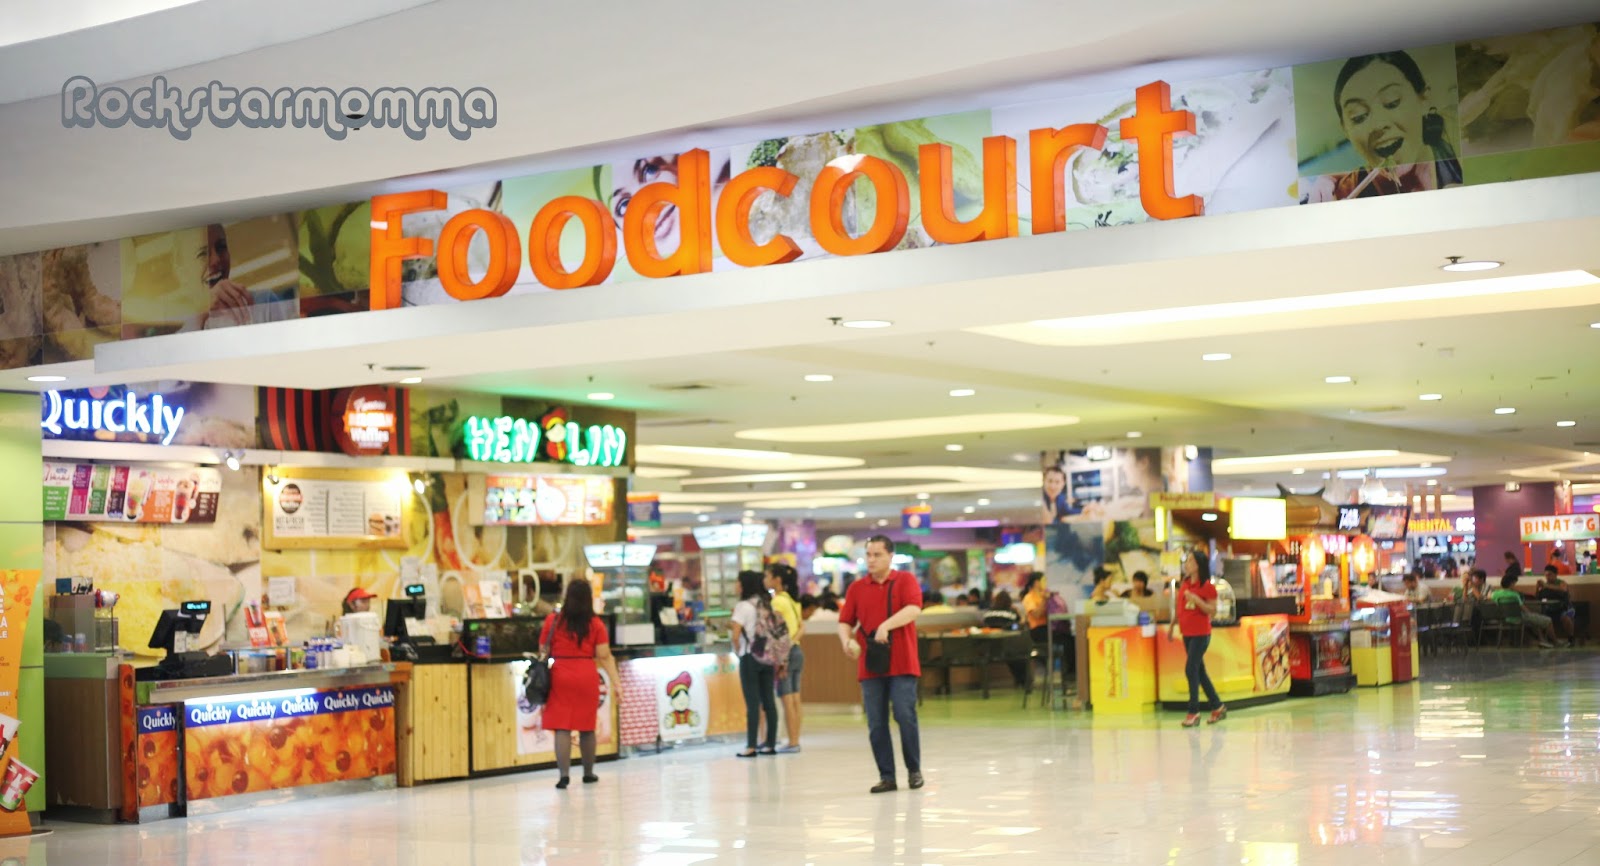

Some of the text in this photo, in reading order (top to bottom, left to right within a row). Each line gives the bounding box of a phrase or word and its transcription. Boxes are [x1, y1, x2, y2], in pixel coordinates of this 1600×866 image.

[368, 80, 1205, 311] Foodcourt
[466, 415, 627, 467] HEN LIN
[1407, 518, 1454, 533] RIENTAL
[143, 711, 176, 730] Quickly
[191, 703, 232, 724] Quickly
[237, 700, 277, 720] Quickly
[281, 695, 319, 714] Quickly
[324, 692, 360, 711] Quickly
